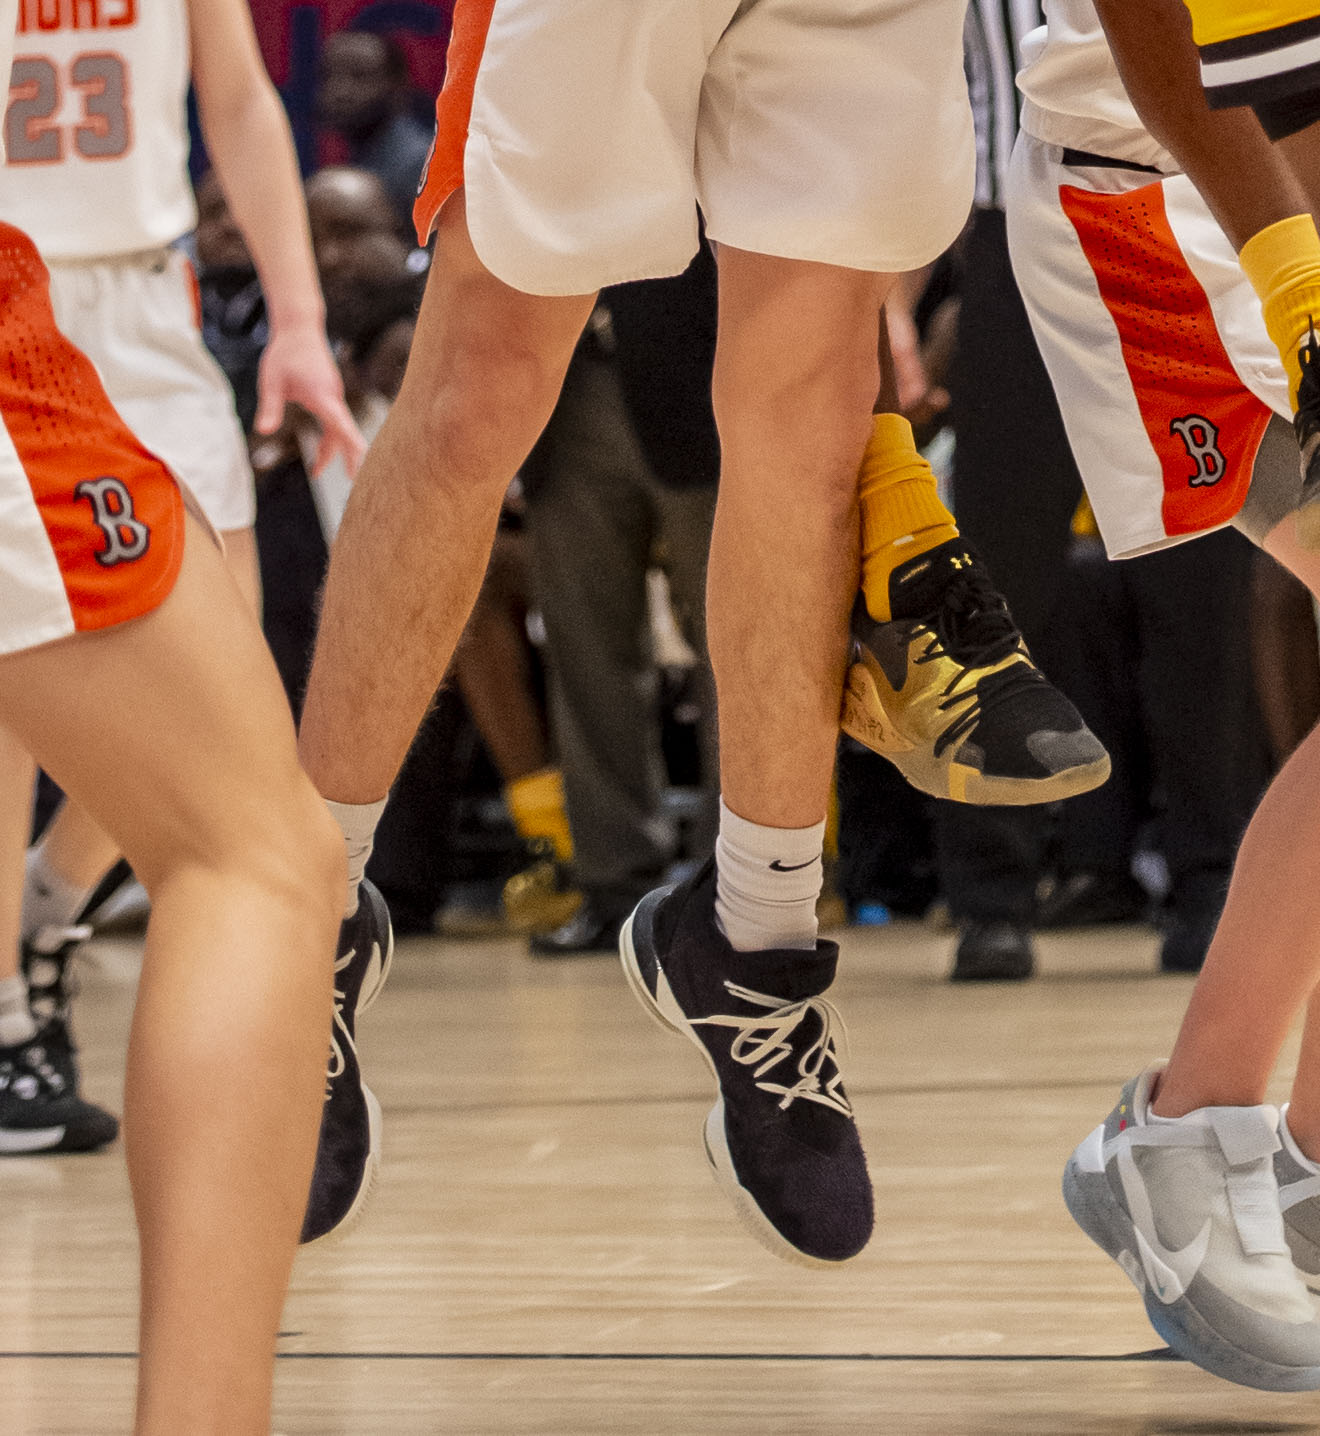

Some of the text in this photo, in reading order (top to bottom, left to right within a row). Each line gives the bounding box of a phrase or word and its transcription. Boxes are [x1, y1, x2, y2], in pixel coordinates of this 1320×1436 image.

[4, 49, 135, 167] 23
[1170, 413, 1227, 489] B
[74, 475, 152, 568] B
